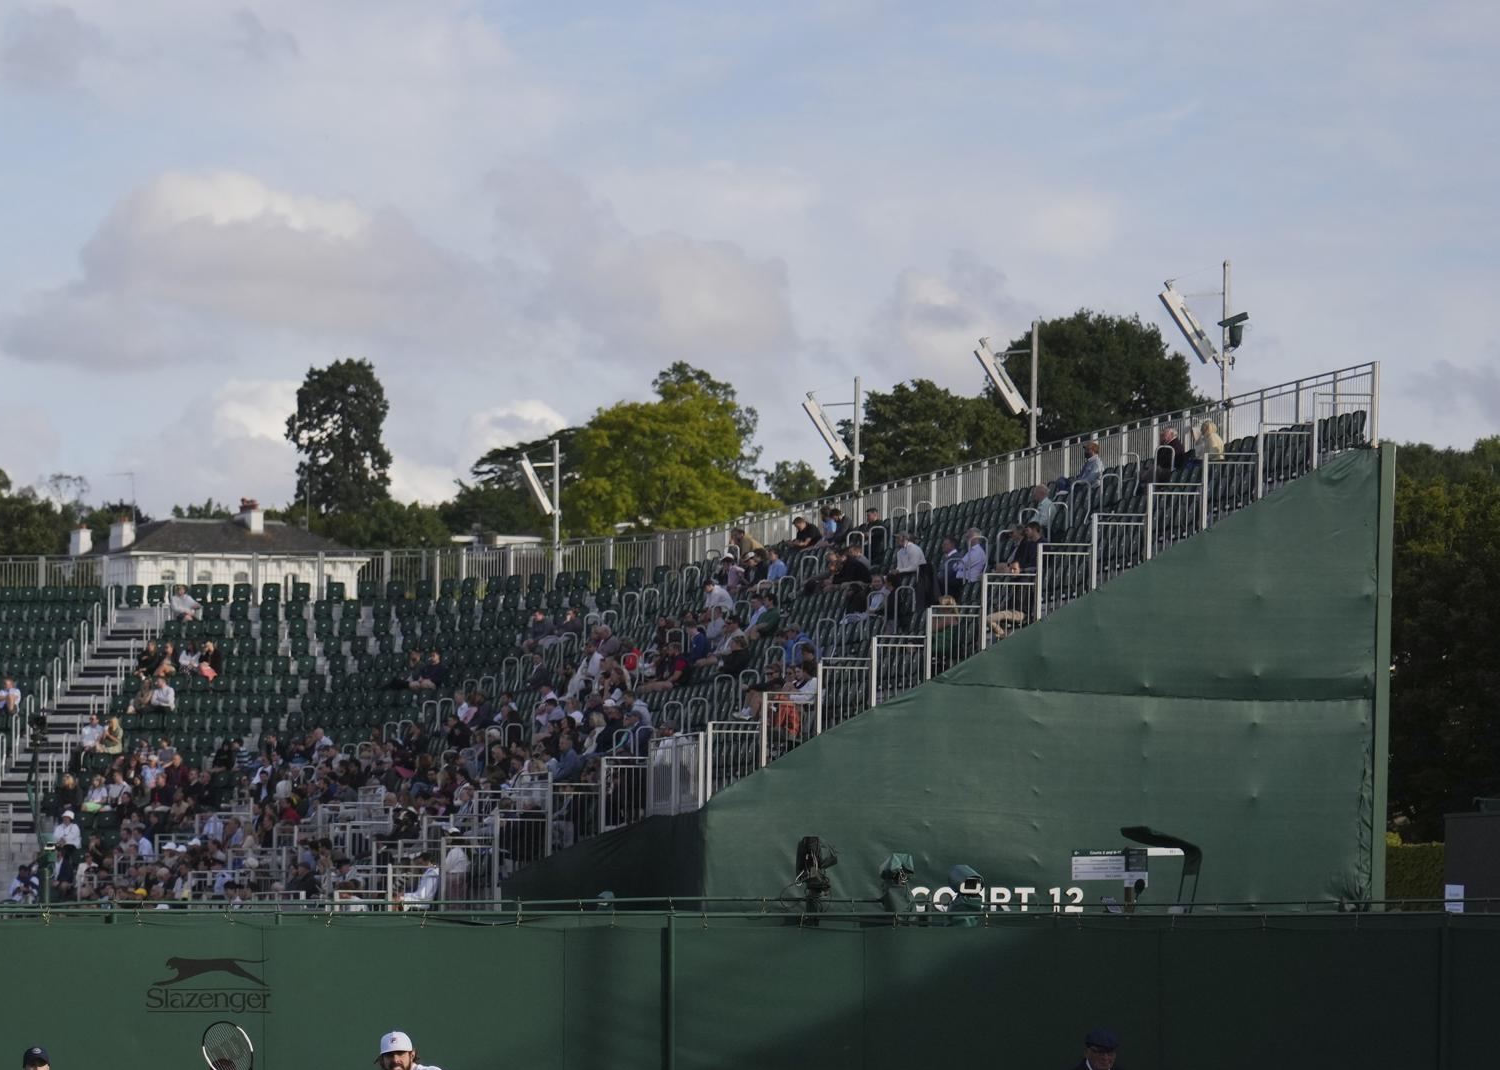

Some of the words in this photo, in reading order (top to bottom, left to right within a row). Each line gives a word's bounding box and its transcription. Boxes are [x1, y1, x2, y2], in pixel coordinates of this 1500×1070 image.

[911, 886, 1036, 912] CORT
[1049, 887, 1084, 913] 12
[146, 987, 272, 1014] Slazenger
